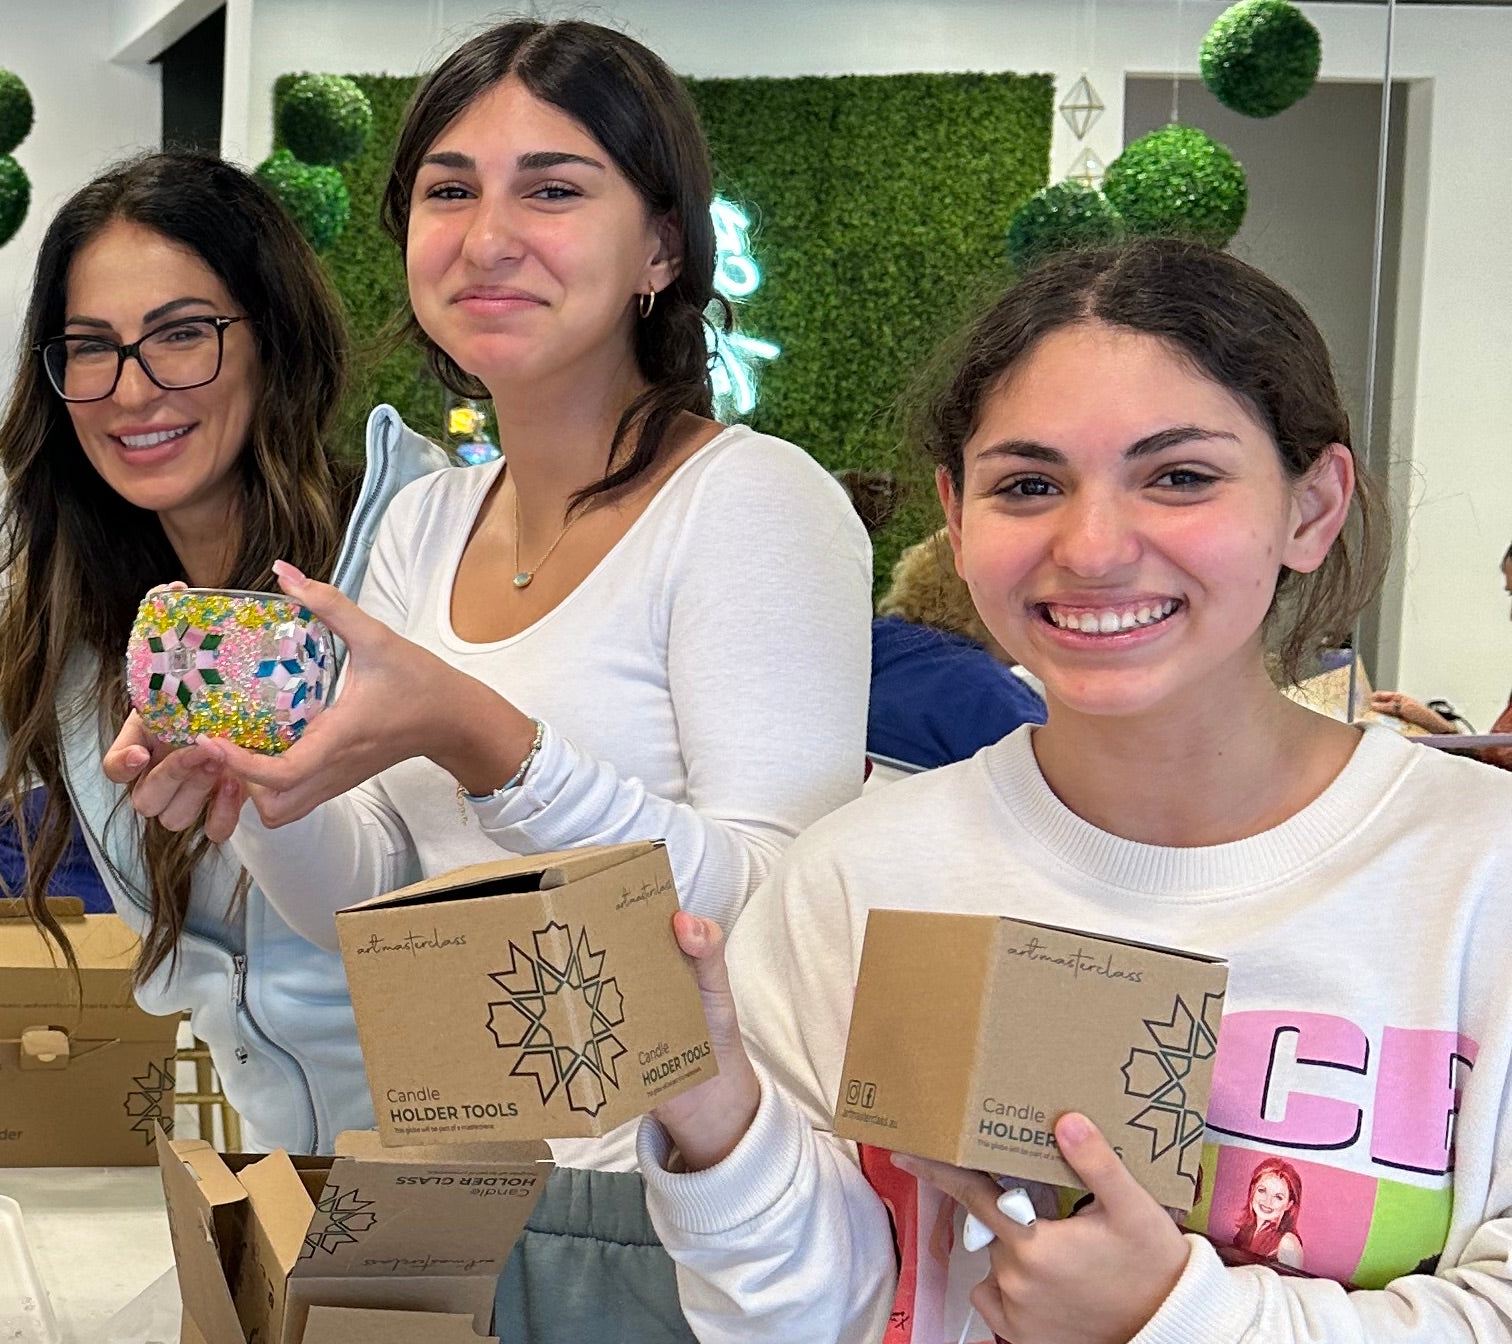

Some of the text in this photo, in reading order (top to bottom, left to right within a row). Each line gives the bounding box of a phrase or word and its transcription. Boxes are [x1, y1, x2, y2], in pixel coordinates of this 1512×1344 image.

[356, 927, 467, 958] artmasterclass
[1007, 936, 1144, 983] artmasterclass
[638, 1041, 670, 1066] Candle
[641, 1056, 682, 1087] HOLDER
[680, 1040, 711, 1066] TOOLS
[386, 1085, 441, 1103] Candle
[390, 1101, 519, 1123] HOLDER TOOLS
[982, 1097, 1046, 1124] Candle
[978, 1118, 1058, 1149] HOLDER
[395, 1175, 537, 1187] HOLDER GLASS
[470, 1187, 530, 1198] Candle
